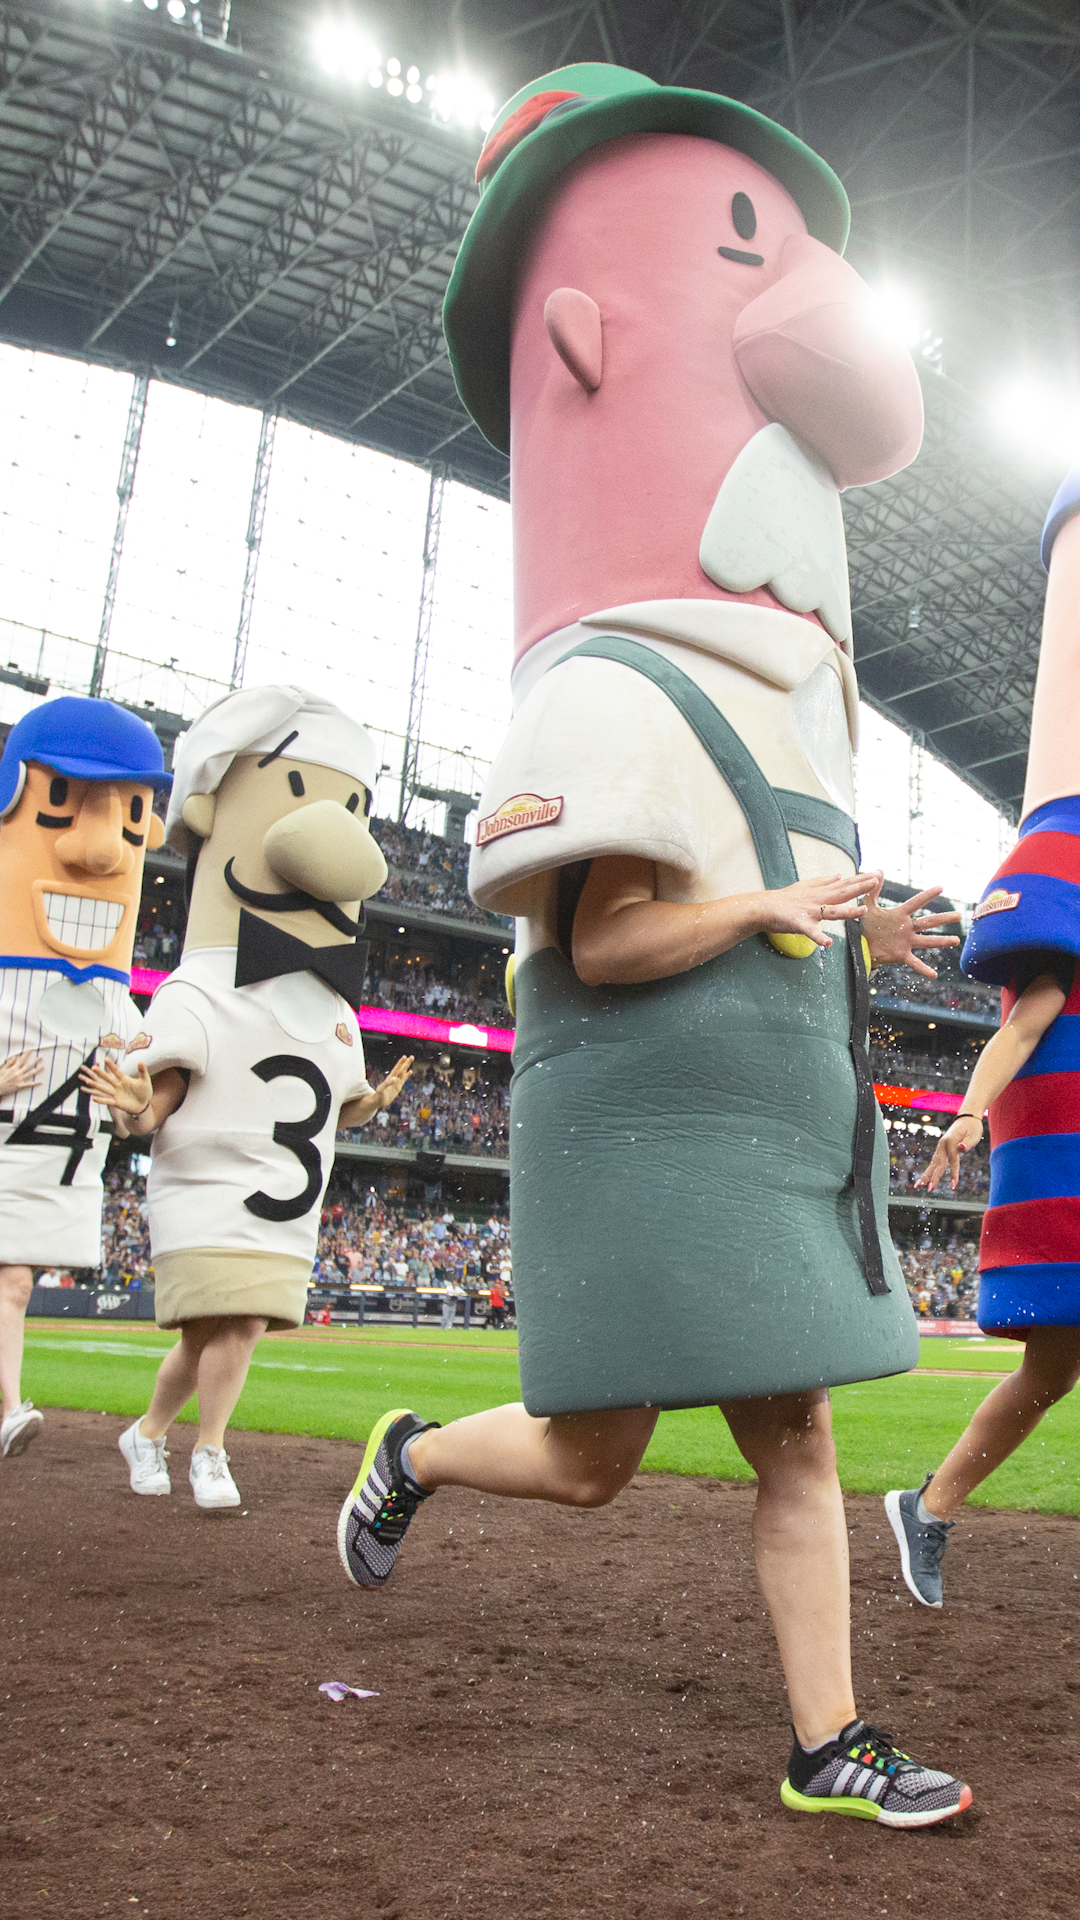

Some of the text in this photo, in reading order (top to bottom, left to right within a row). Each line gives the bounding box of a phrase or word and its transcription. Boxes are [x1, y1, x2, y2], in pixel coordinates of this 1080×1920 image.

[481, 803, 558, 840] Johnsonville
[5, 1046, 98, 1186] 4
[243, 1054, 332, 1222] 3
